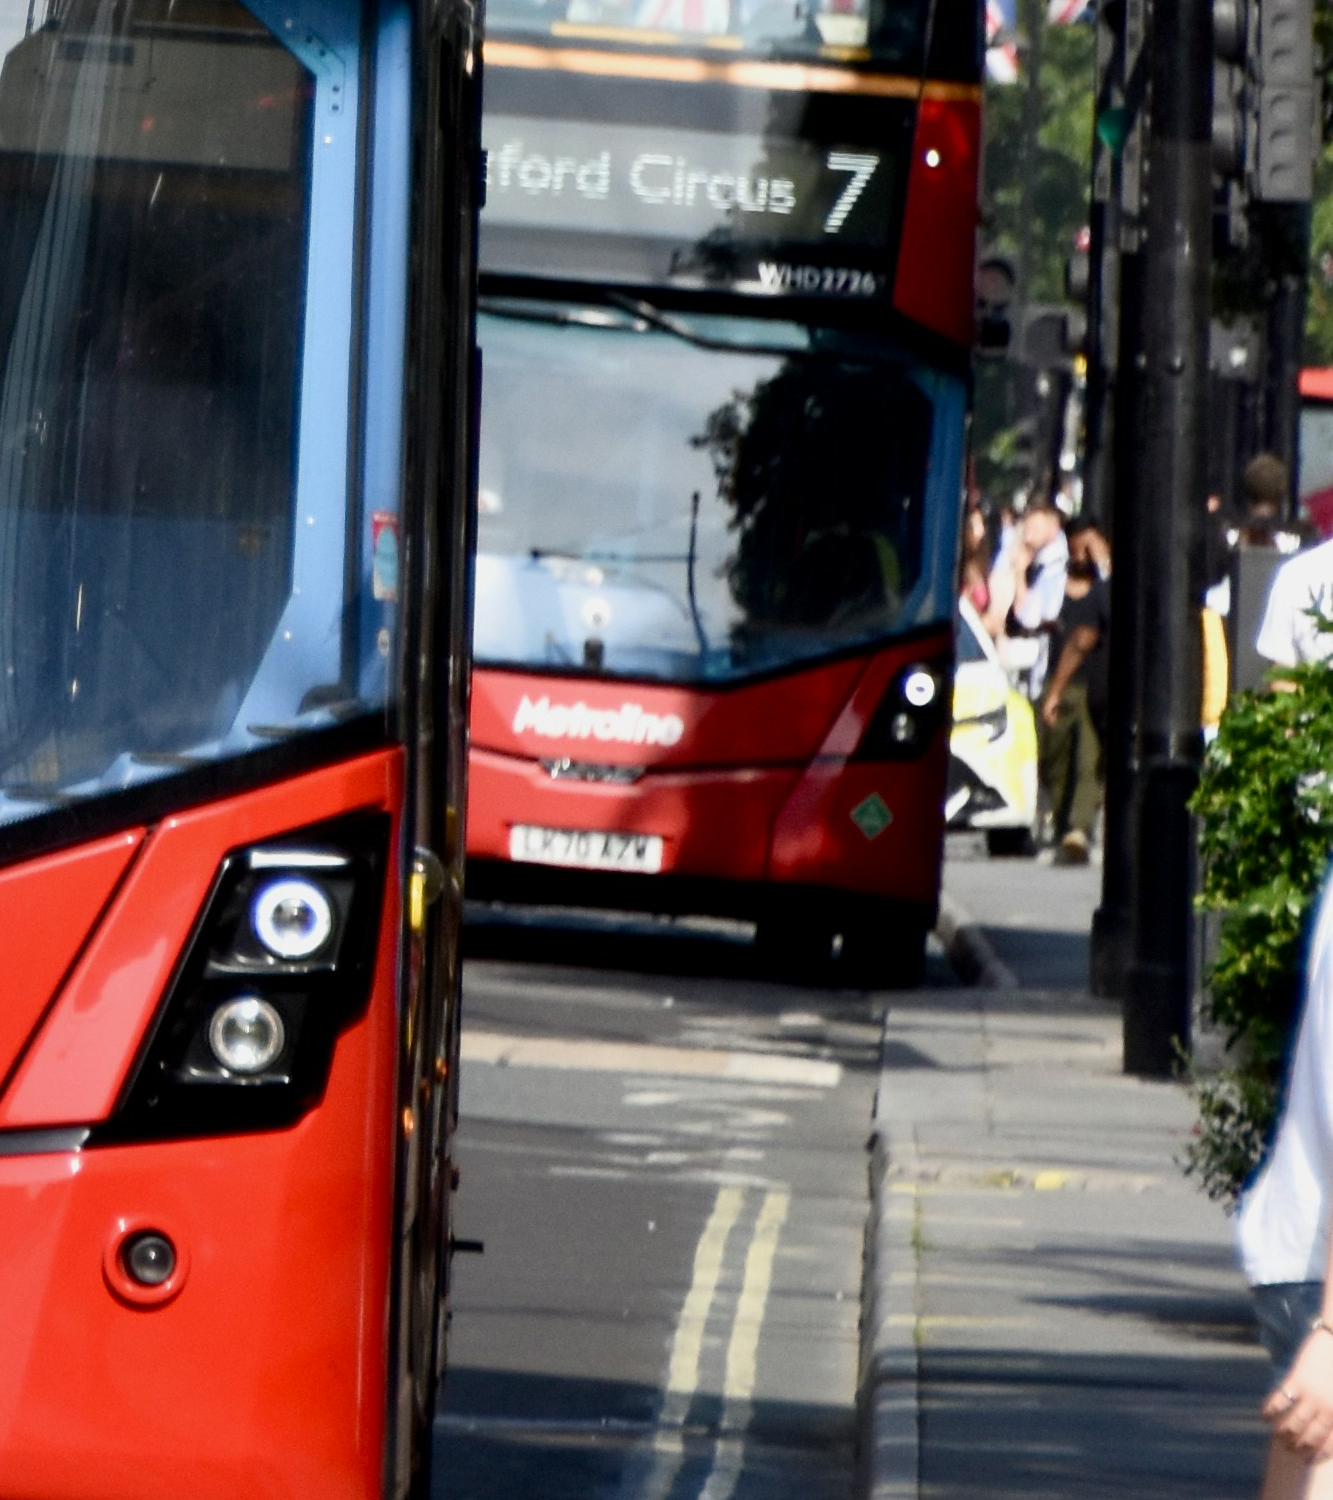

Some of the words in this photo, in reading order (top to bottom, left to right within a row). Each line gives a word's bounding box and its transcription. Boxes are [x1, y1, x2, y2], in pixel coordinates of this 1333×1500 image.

[485, 138, 611, 200] ford
[629, 152, 797, 215] Circus
[823, 151, 881, 234] 7
[512, 694, 685, 747] Metroline
